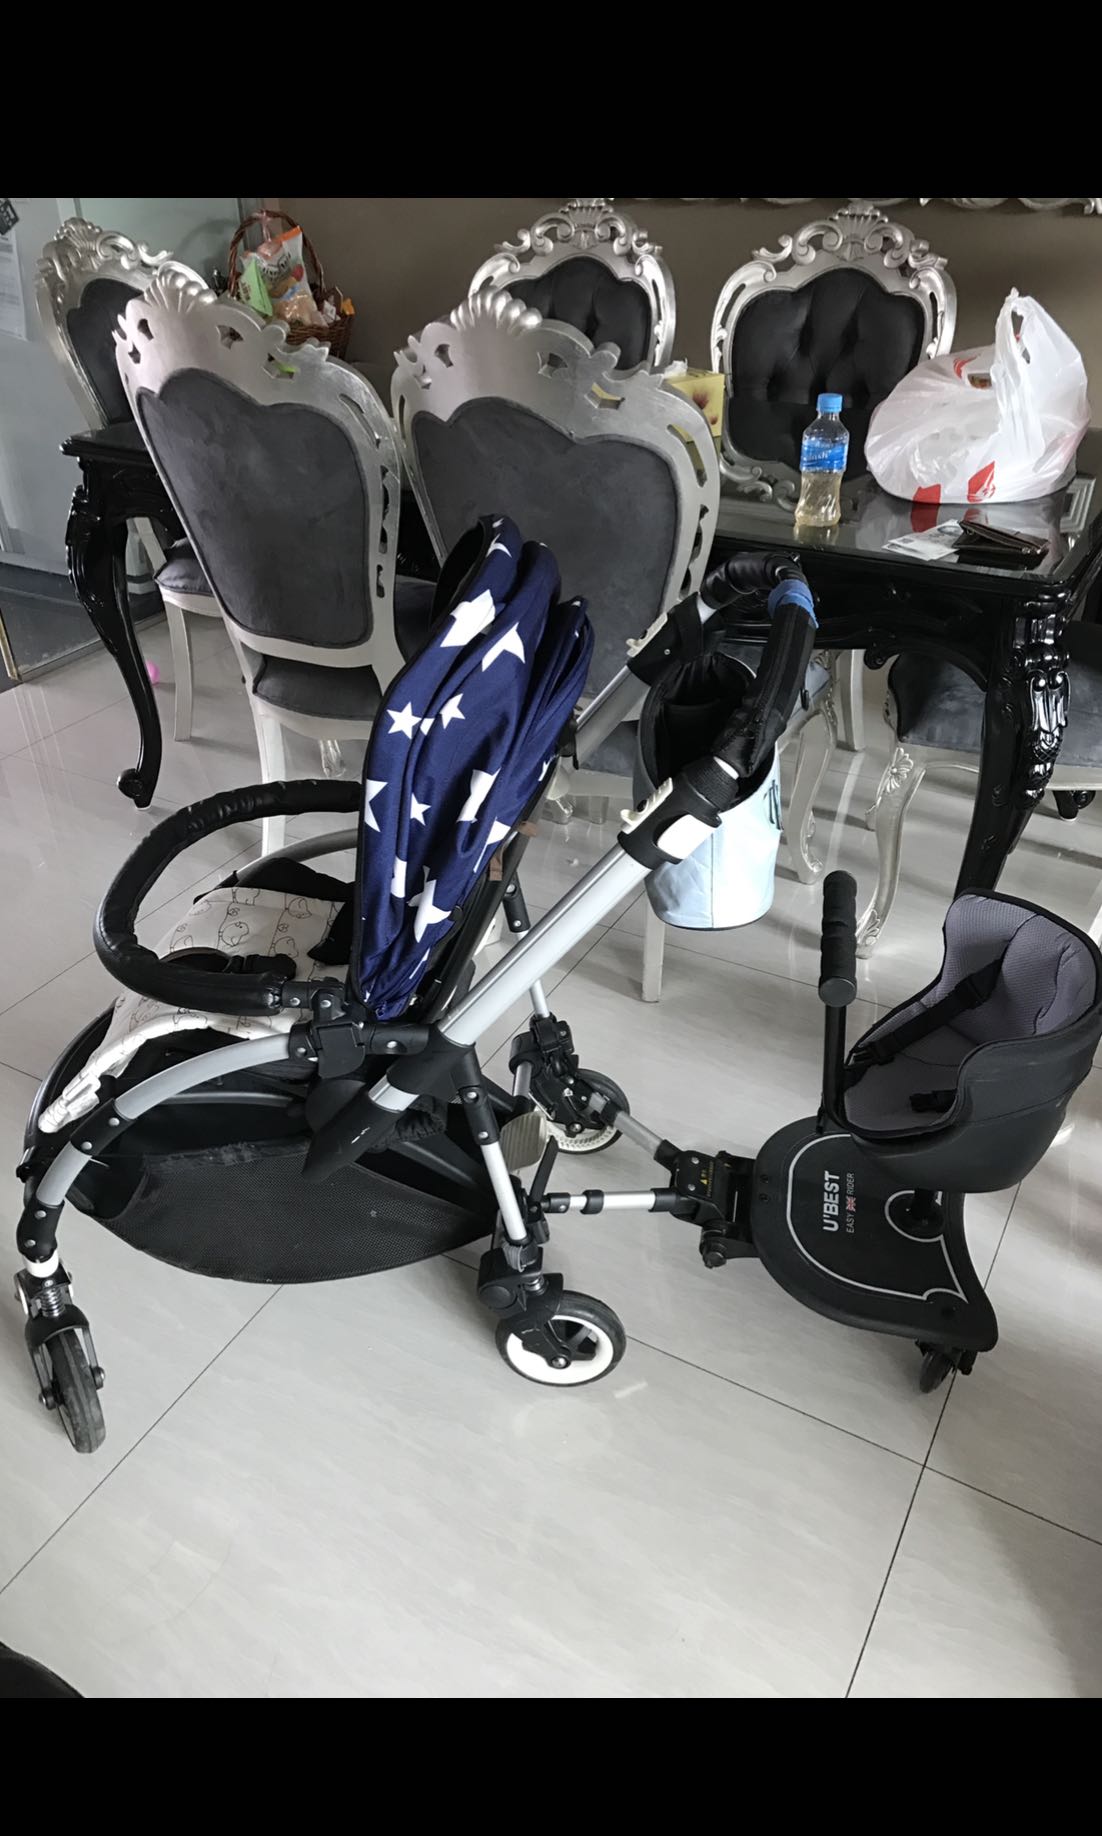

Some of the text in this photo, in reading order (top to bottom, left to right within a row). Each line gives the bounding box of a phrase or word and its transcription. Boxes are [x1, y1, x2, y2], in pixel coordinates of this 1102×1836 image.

[823, 1170, 840, 1231] U'BEST
[846, 1173, 855, 1233] EASY RIDER
